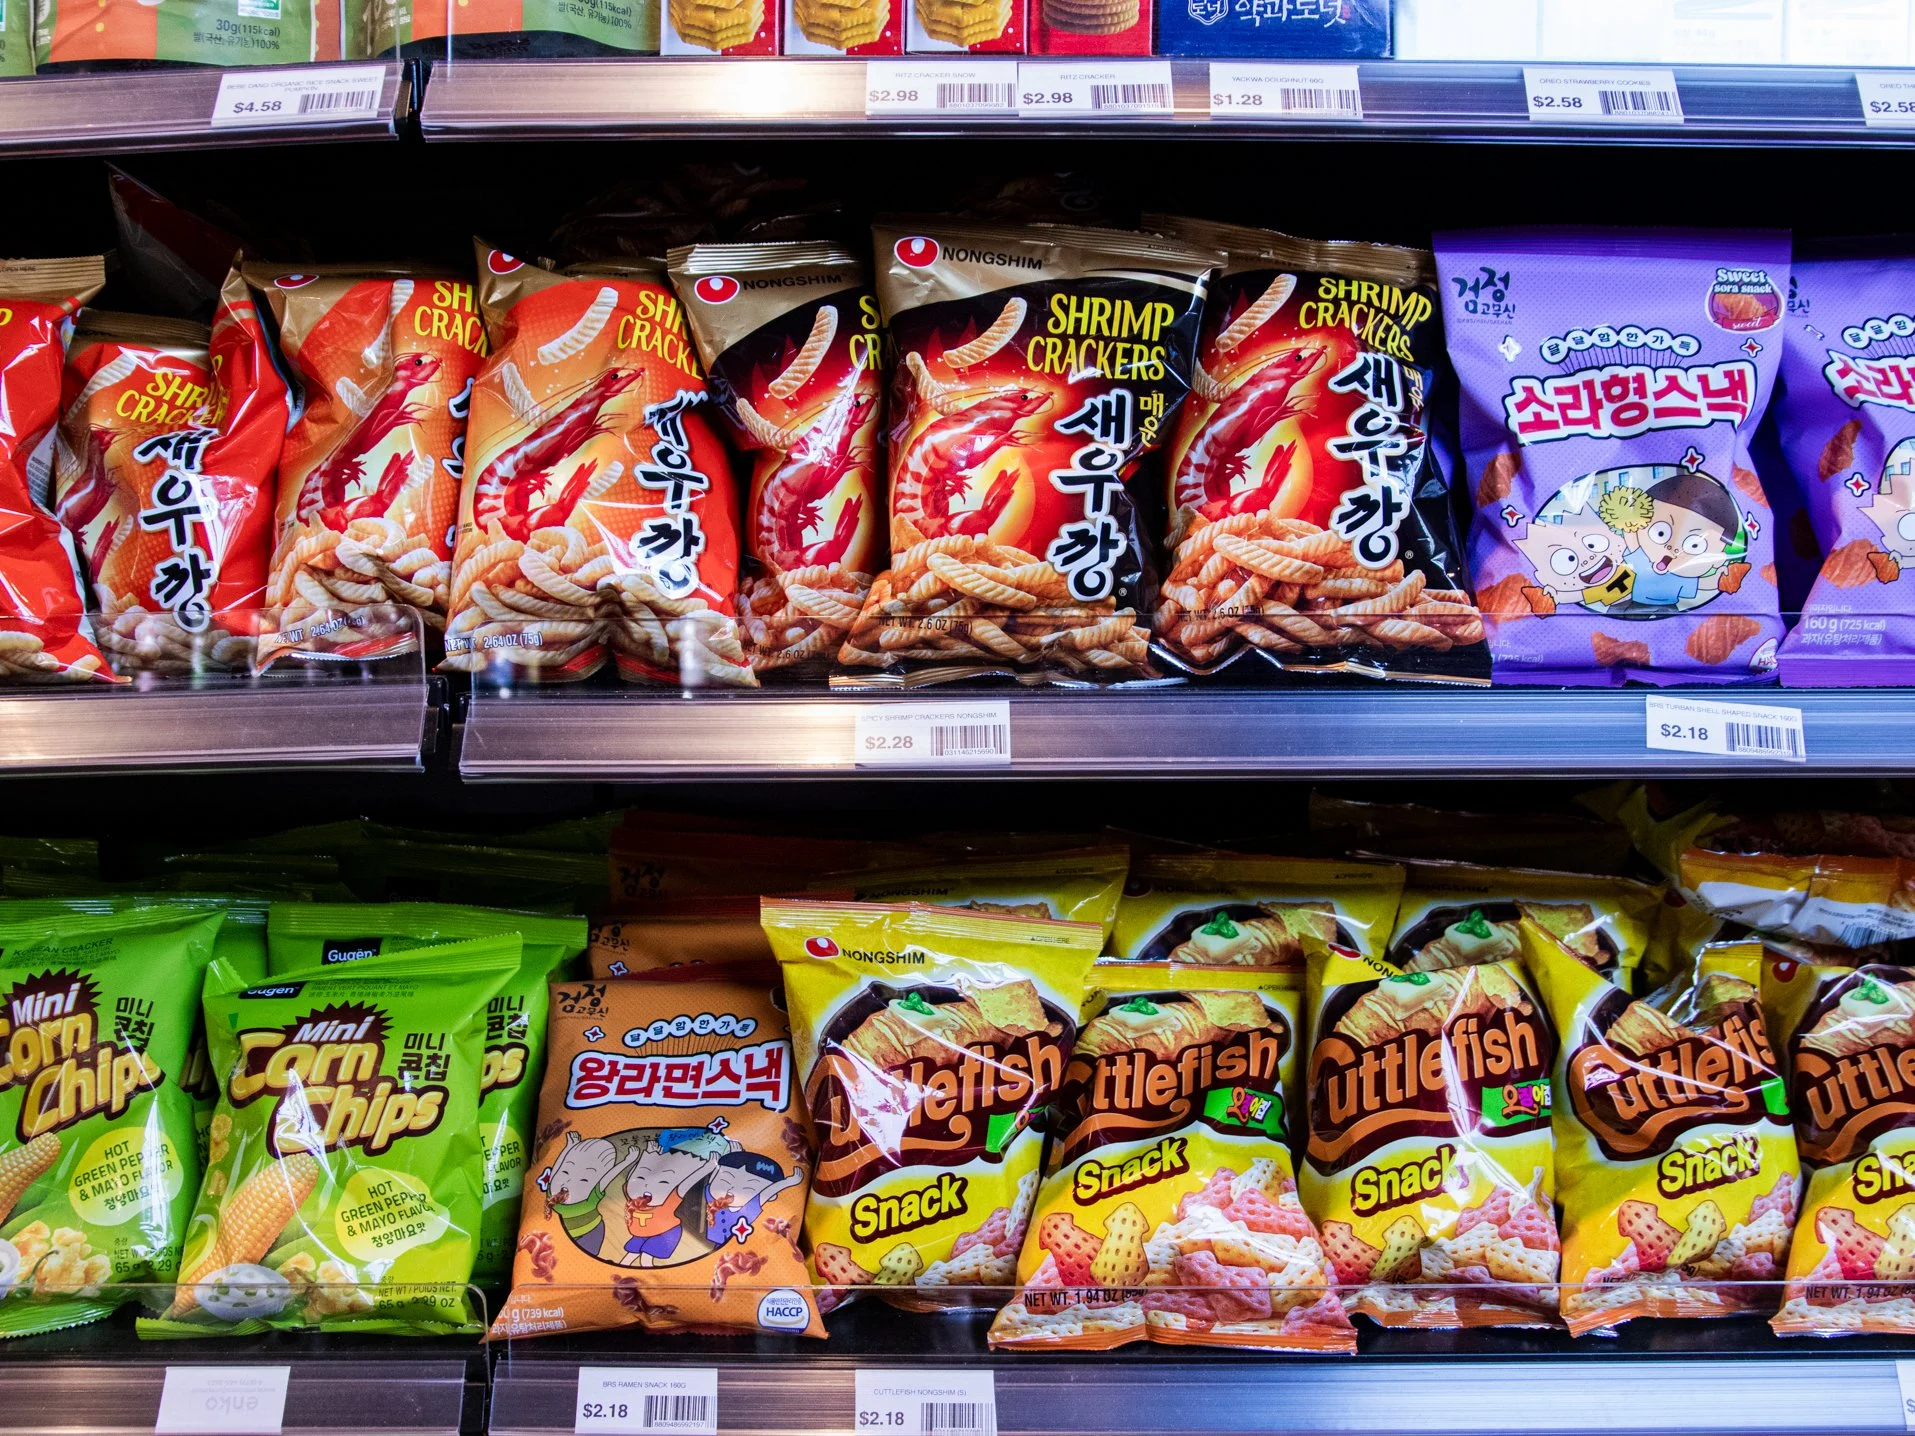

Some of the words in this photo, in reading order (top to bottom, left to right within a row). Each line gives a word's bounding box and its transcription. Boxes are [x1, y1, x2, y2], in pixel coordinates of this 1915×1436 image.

[869, 89, 919, 103] $2.98
[1023, 92, 1073, 106] $2.98
[1213, 93, 1263, 106] $1.28
[1532, 95, 1583, 109] $2.58
[233, 100, 282, 114] $4.58
[943, 246, 1042, 270] NONGSHIM
[743, 274, 842, 291] NONGSHIM
[1716, 268, 1767, 283] Sweet
[1713, 283, 1739, 294] sora
[1740, 283, 1773, 294] snack
[1318, 277, 1432, 331] SHRIMP
[1047, 293, 1174, 342] SHRIMP
[1732, 317, 1763, 330] sweet
[1299, 301, 1415, 363] CRACKERS
[1027, 337, 1165, 380] CRACKERS
[1836, 356, 1915, 406] 소라
[1514, 367, 1750, 435] 소라형스낵
[1331, 354, 1407, 568] 새우깡
[1053, 392, 1129, 599] 새우깡
[309, 620, 332, 638] 2.64
[918, 619, 933, 633] 2.6
[935, 621, 948, 632] OZ
[950, 621, 973, 636] (75g)
[1802, 616, 1827, 632] 160
[1828, 619, 1839, 634] g
[1839, 619, 1862, 631] (725
[1862, 618, 1887, 631] kcal)
[483, 633, 506, 650] 2.64
[505, 633, 519, 648] OZ
[519, 630, 543, 649] (75g)
[884, 714, 914, 722] SHRIMP
[914, 713, 956, 721] CRACKERS
[956, 712, 997, 720] NONGSHIM
[1666, 704, 1696, 712] TURBAN
[1696, 706, 1721, 715] SHELL
[1721, 709, 1752, 718] SHAPED
[1753, 712, 1777, 720] SNACK
[1660, 722, 1709, 741] $2.18
[865, 735, 914, 750] $2.28
[842, 947, 926, 966] NONGSHIM
[12, 982, 81, 1027] Mini
[115, 996, 155, 1019] 미니
[292, 1015, 376, 1043] Mini
[0, 1012, 93, 1086] orn
[403, 1032, 446, 1052] 미니
[230, 1031, 380, 1101] Corn
[573, 1046, 784, 1103] 왕라면스낵
[22, 1047, 163, 1137] Chips
[1307, 1012, 1539, 1162] Cuttlefish
[276, 1081, 444, 1153] Chips
[104, 1140, 131, 1161] HOT
[1075, 1139, 1187, 1203] Snack
[1659, 1129, 1759, 1197] Snack
[74, 1162, 119, 1189] GREEN
[1353, 1146, 1462, 1213] Snack
[78, 1189, 91, 1203] &
[91, 1174, 131, 1197] MAYO
[367, 1180, 393, 1200] HOT
[340, 1200, 384, 1224] GREEN
[853, 1176, 966, 1238] Snack
[347, 1224, 357, 1238] &
[359, 1211, 397, 1235] MAYO
[371, 1221, 427, 1249] 청양마요맛
[115, 1261, 131, 1274] 65
[440, 1297, 456, 1308] OZ
[1024, 1291, 1047, 1307] NET
[1048, 1290, 1072, 1305] WT.
[1074, 1289, 1100, 1305] 1.94
[1805, 1286, 1828, 1299] NET
[1830, 1285, 1851, 1300] WT.
[1856, 1285, 1881, 1300] 1.94
[521, 1307, 542, 1320] (739
[543, 1306, 564, 1319] kcal)
[766, 1306, 803, 1317] HACCP
[873, 1388, 916, 1396] CUTTLEFISH
[957, 1389, 967, 1397] (S)
[582, 1402, 628, 1419] $2.18
[859, 1411, 905, 1426] $2.18
